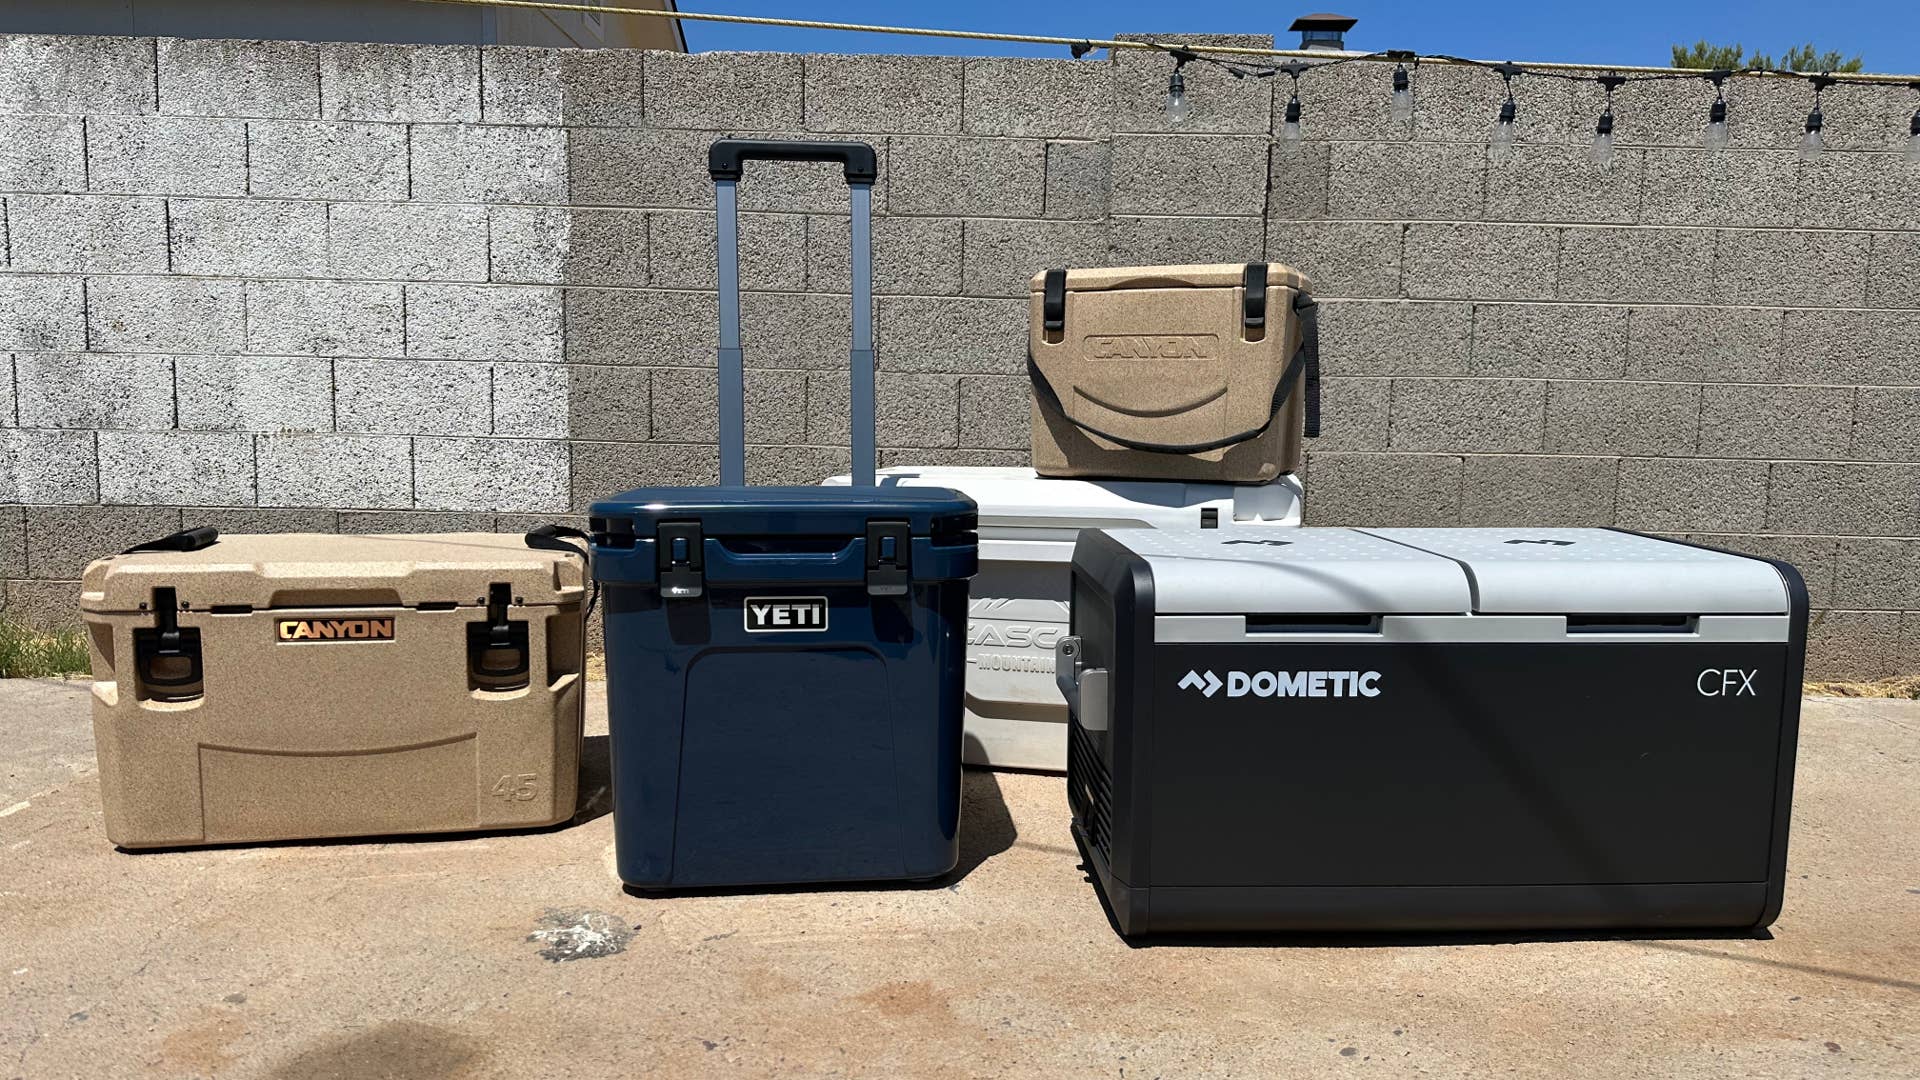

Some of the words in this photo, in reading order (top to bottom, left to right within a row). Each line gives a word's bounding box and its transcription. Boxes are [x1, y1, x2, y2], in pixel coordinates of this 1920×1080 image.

[1094, 337, 1207, 359] CANYON
[750, 604, 820, 625] YETI
[279, 620, 392, 639] CANYON
[967, 624, 1059, 650] ASC
[1227, 670, 1382, 697] DOMETIC
[1696, 668, 1758, 696] CFX
[491, 772, 538, 802] 45
